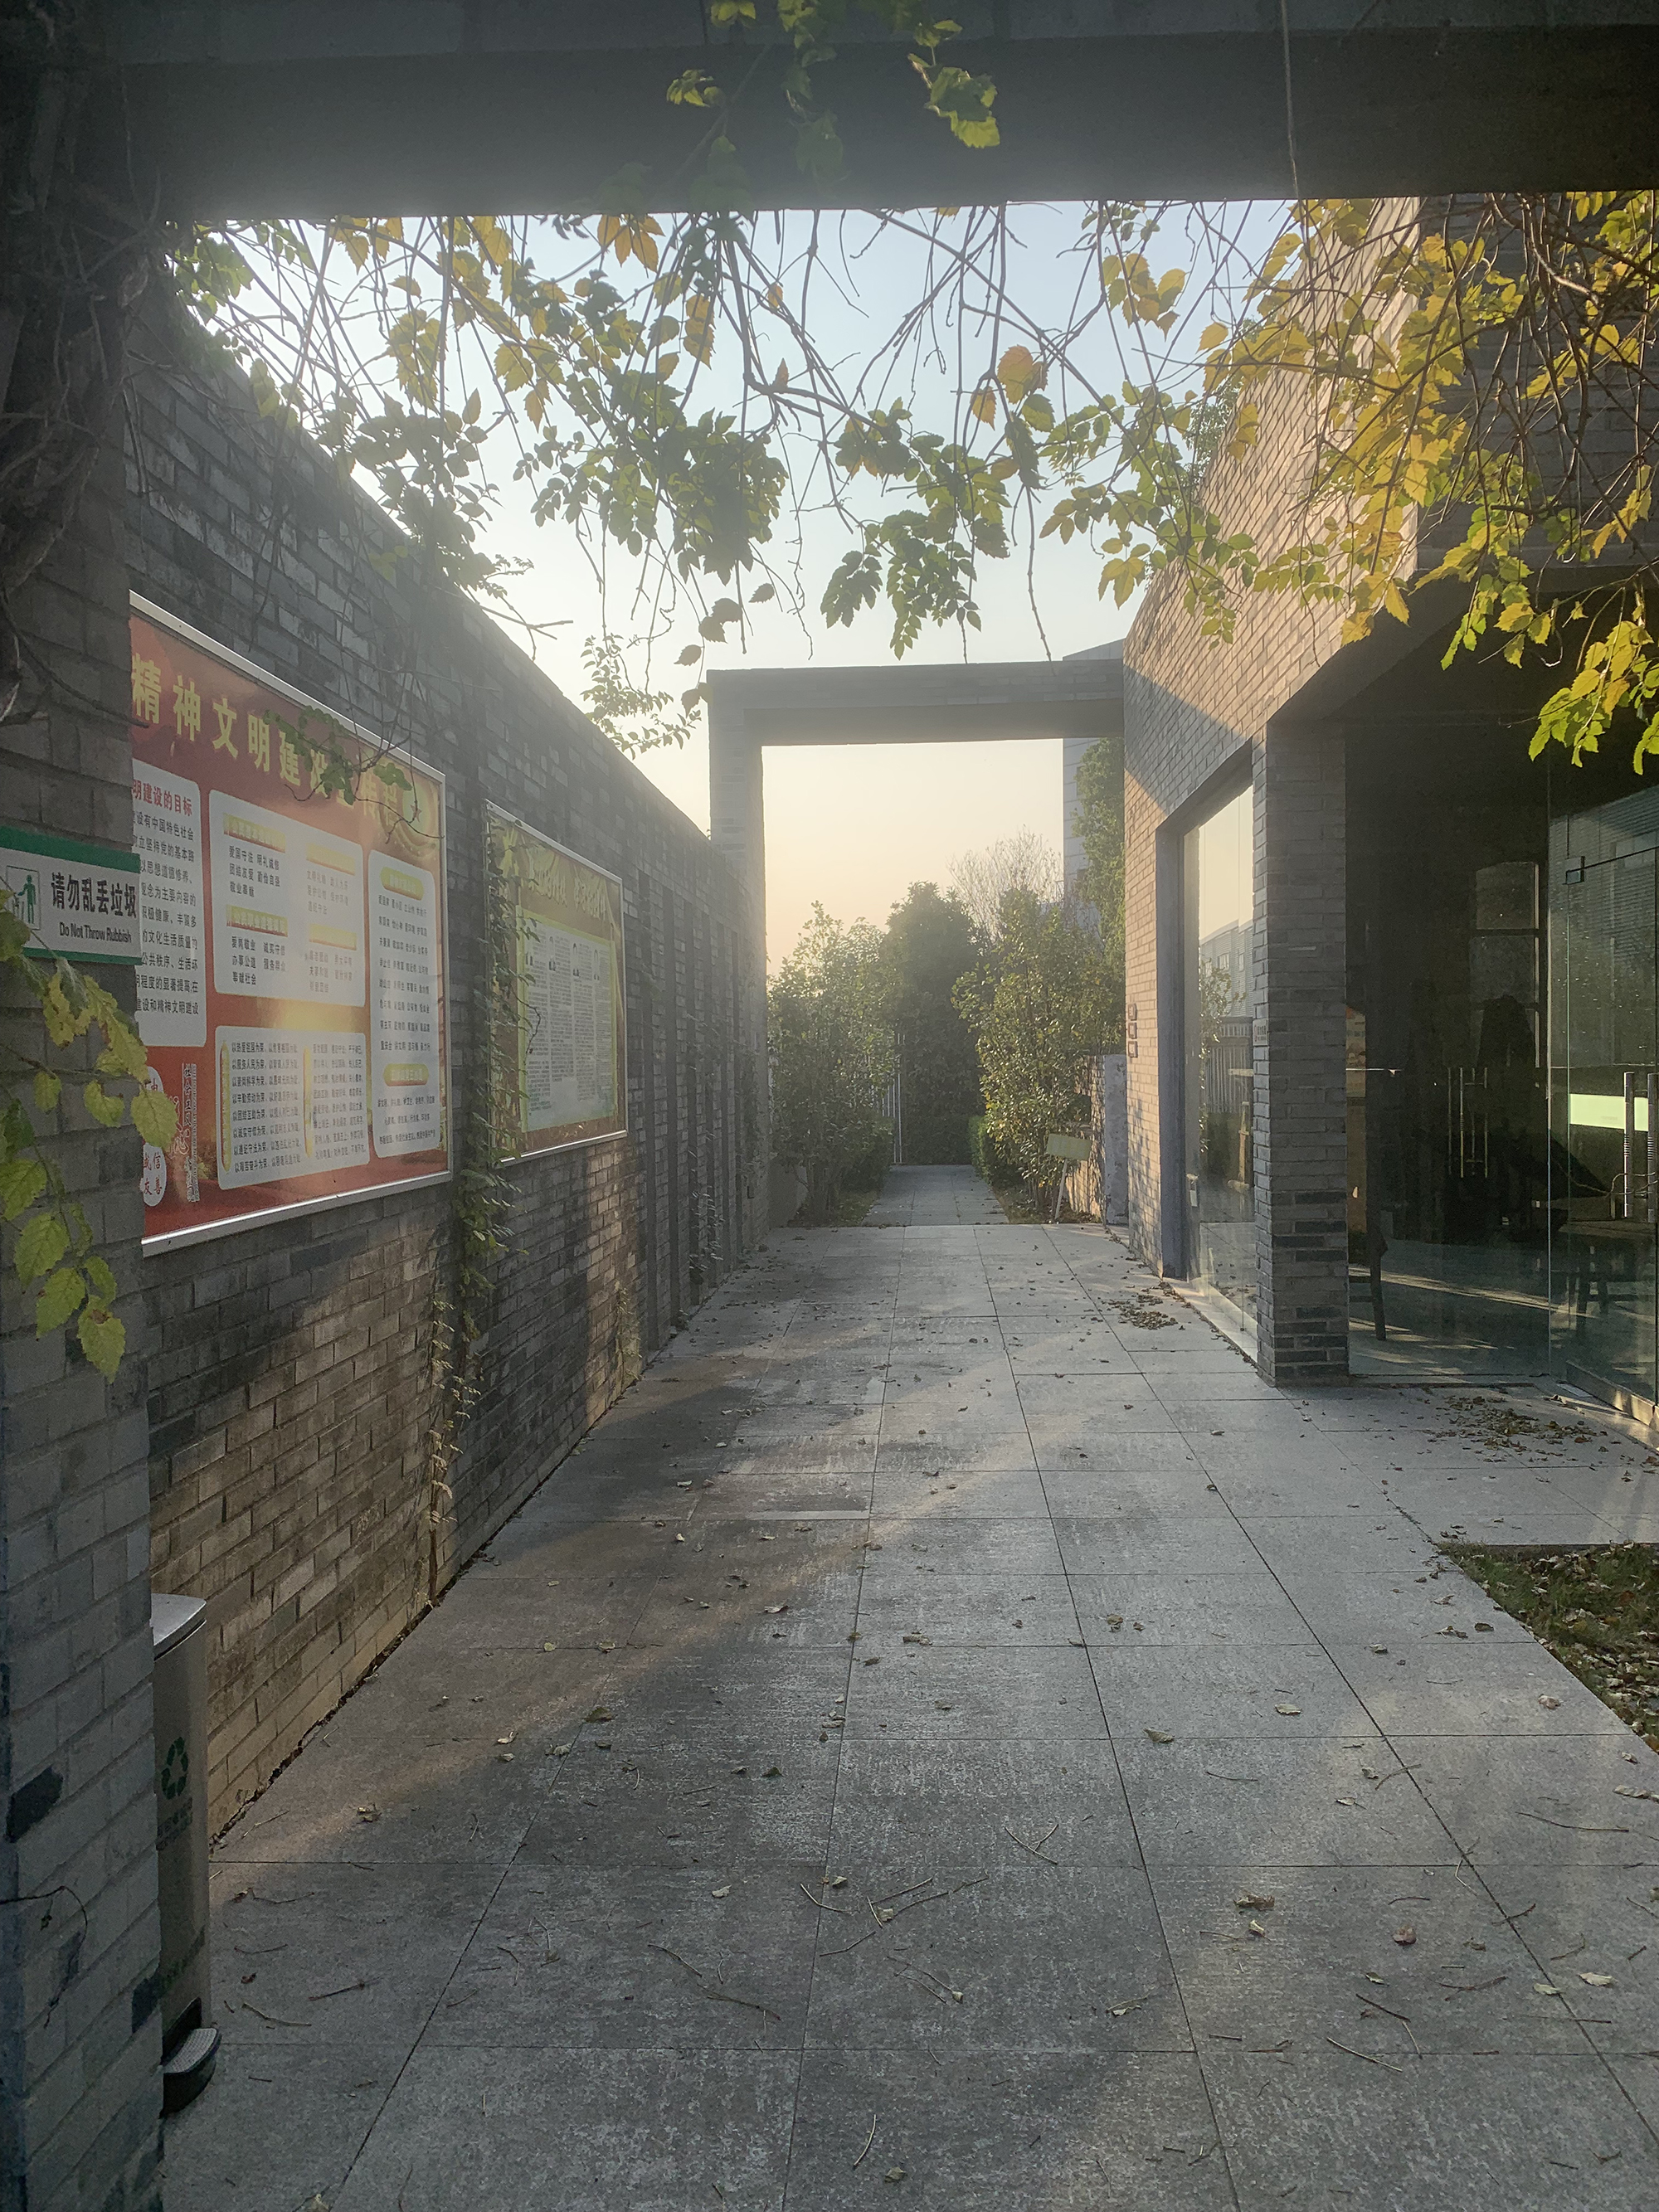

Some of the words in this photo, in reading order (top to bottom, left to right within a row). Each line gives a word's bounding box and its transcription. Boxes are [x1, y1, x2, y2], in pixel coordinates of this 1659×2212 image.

[131, 652, 397, 827] 精神文明建设传栏
[131, 779, 192, 817] 明建设的目标
[51, 872, 137, 919] 请勿乱丢垃圾
[59, 921, 70, 937] Do
[70, 923, 83, 939] Not
[84, 924, 105, 941] Throw
[105, 926, 132, 943] Rubbish
